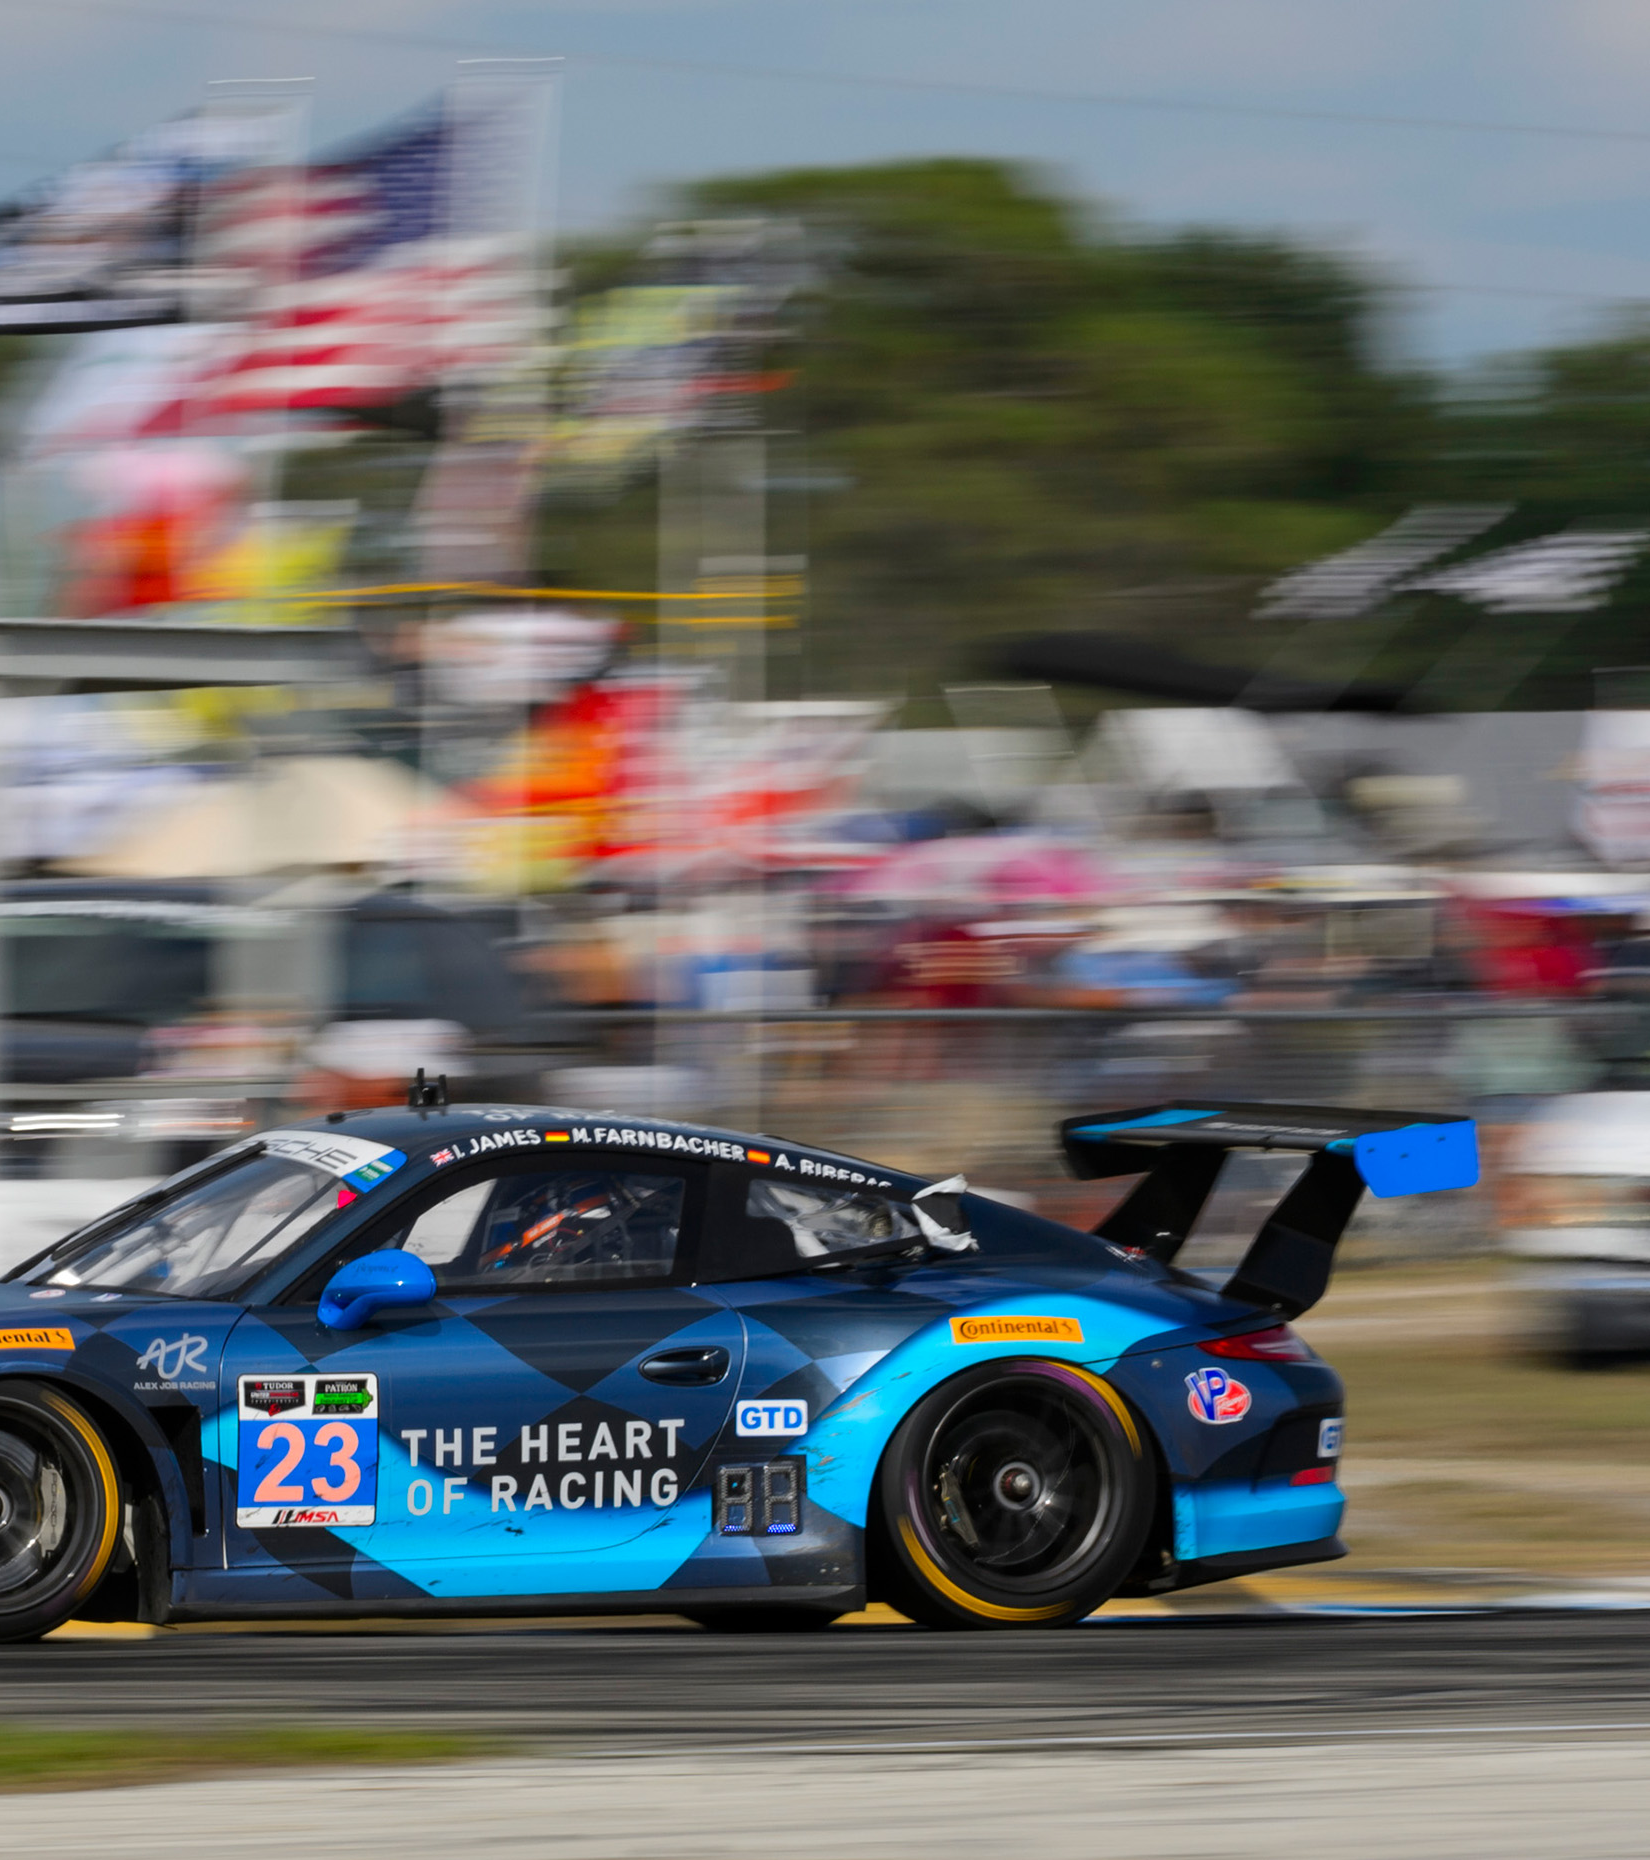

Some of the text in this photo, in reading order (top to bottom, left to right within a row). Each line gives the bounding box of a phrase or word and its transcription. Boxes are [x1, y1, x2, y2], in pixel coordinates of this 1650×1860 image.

[469, 1129, 541, 1154] JAMES
[572, 1128, 745, 1162] M. FARNBACHER
[775, 1153, 796, 1172] A.
[960, 1319, 1060, 1340] Continental
[133, 1381, 216, 1390] ALEX JOB RACING
[262, 1382, 294, 1390] TUDOR
[741, 1406, 803, 1430] GTD
[401, 1418, 685, 1467] THE HEART
[253, 1421, 362, 1502] 23
[407, 1468, 678, 1516] OF RACING
